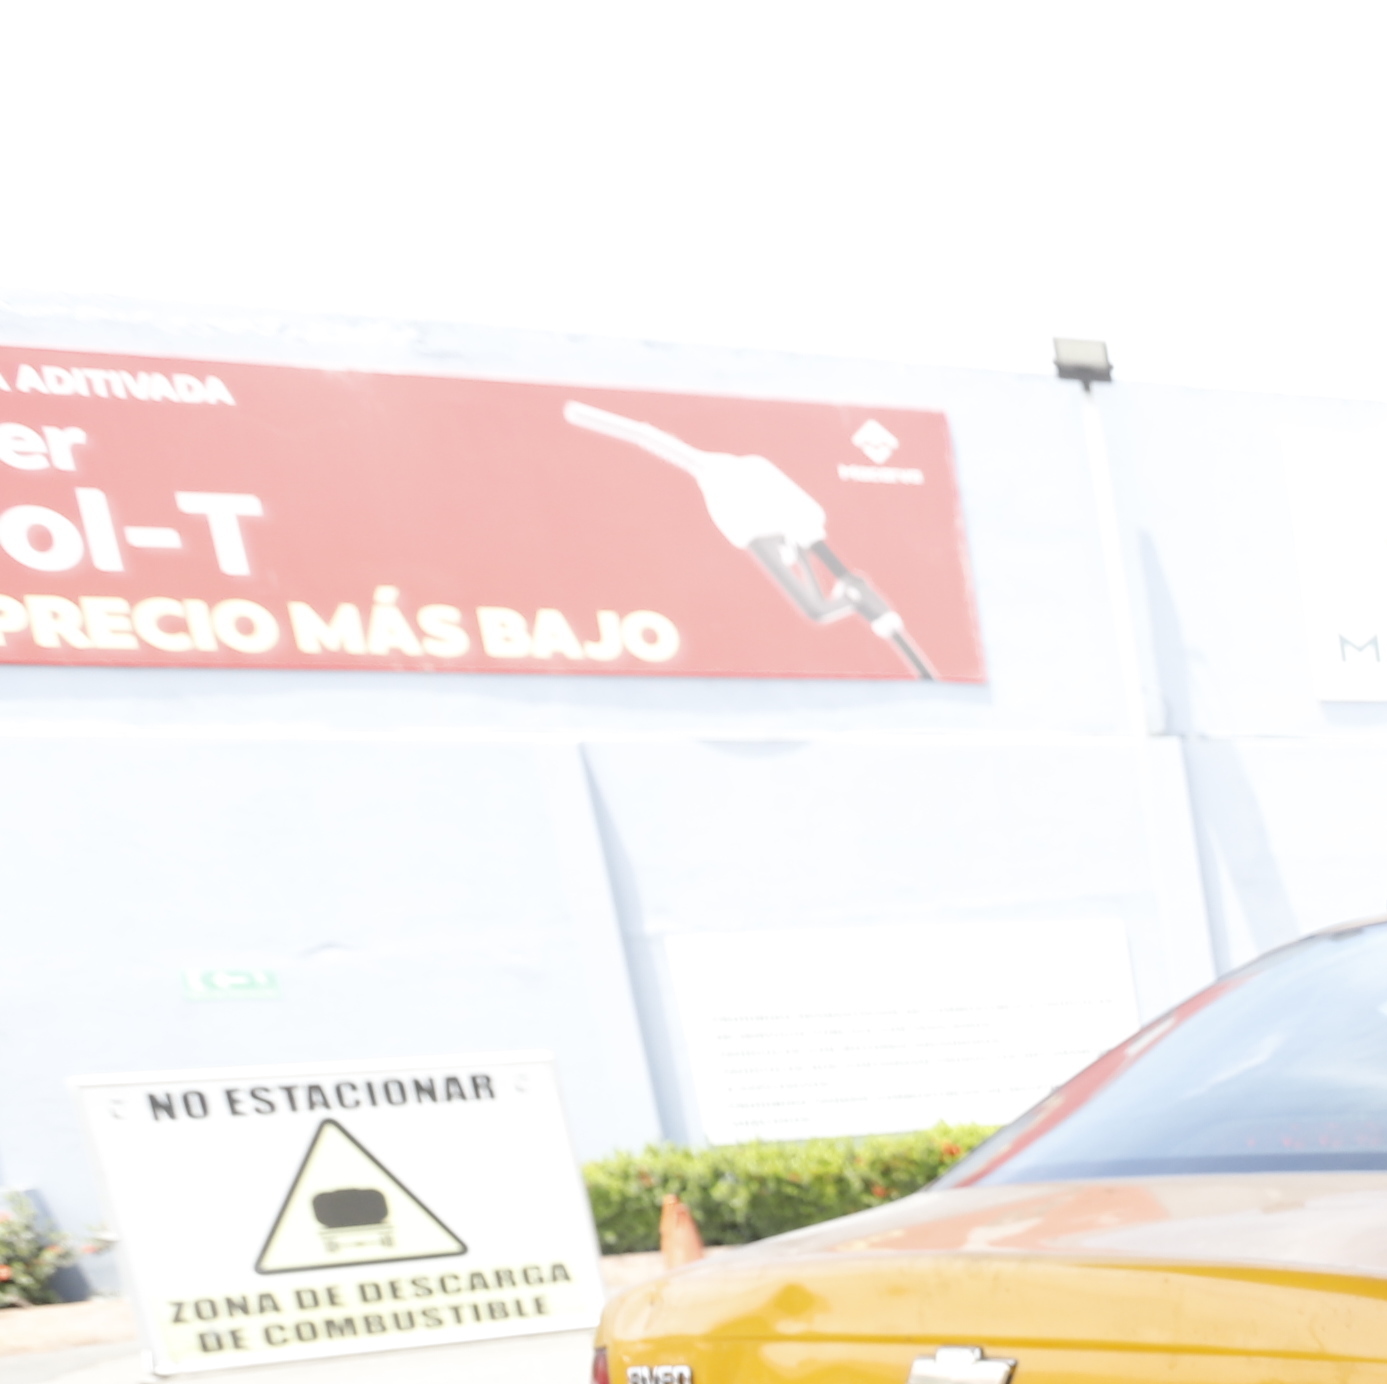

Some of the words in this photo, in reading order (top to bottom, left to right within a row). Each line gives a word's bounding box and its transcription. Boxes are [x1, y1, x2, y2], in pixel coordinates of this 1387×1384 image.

[16, 363, 237, 406] ADITIVADA
[0, 422, 87, 471] er
[0, 487, 264, 576] ol-T
[0, 593, 281, 654] PRECIO
[287, 584, 470, 658] MÁS
[475, 605, 681, 662] BAJO
[147, 1091, 209, 1121] NO
[224, 1074, 496, 1116] ESTACIONAR
[169, 1291, 281, 1324] ZONA
[295, 1283, 344, 1311] DE
[358, 1263, 571, 1304] DESCARGA
[198, 1327, 252, 1353] DE
[263, 1294, 551, 1347] COMBUSTIBLE
